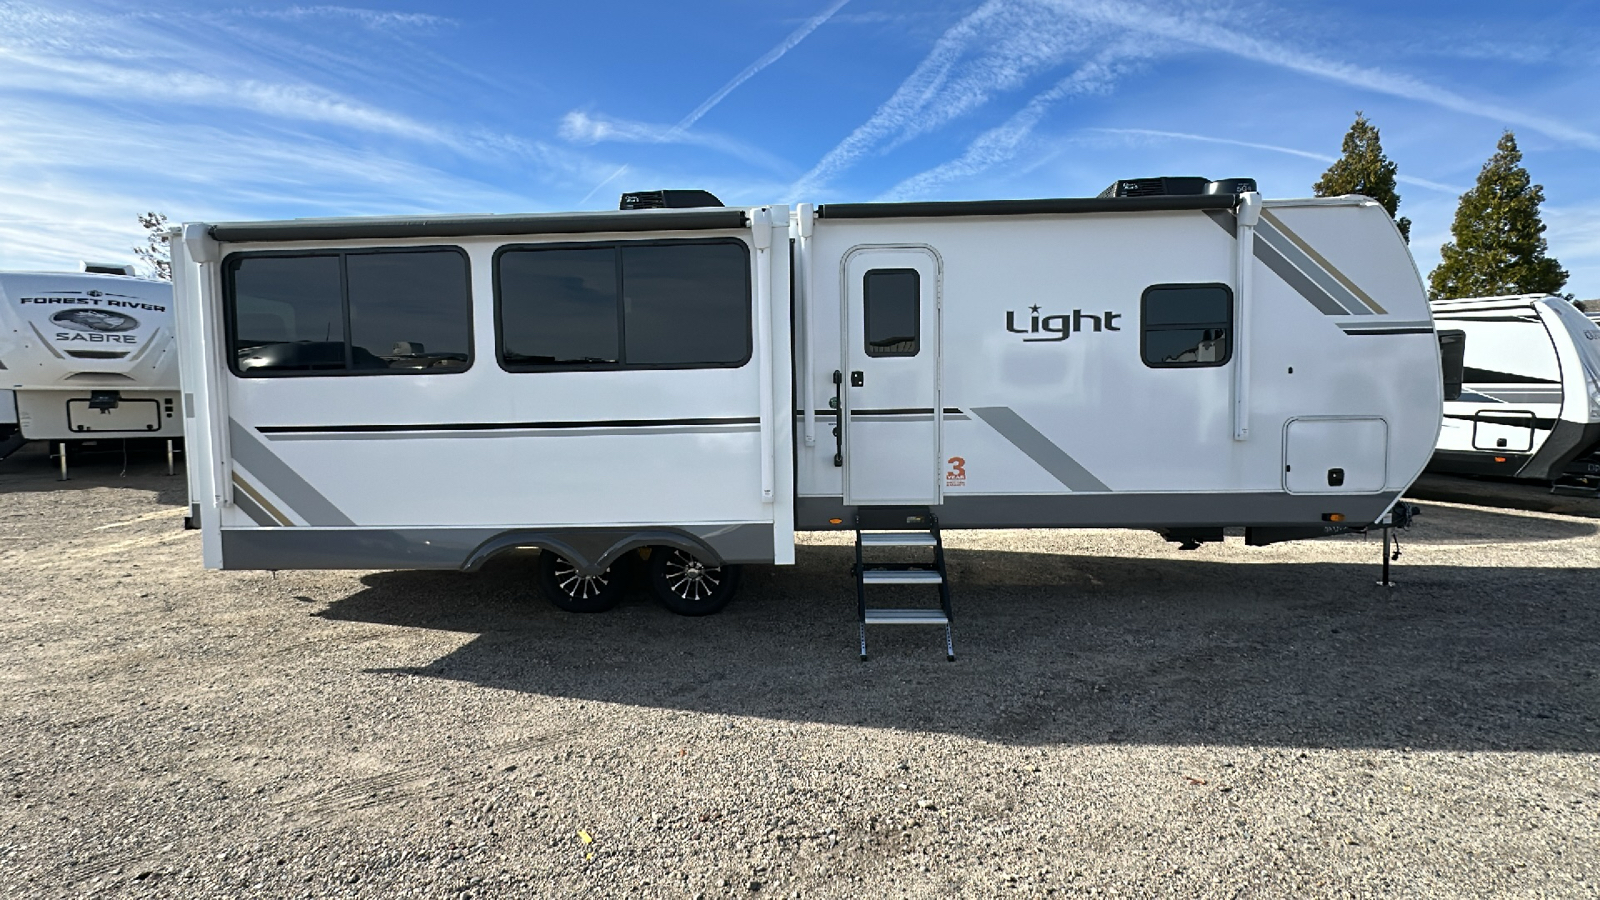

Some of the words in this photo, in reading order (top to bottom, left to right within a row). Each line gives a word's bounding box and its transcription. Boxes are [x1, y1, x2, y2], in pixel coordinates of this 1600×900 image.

[20, 297, 102, 305] FOREST
[108, 300, 166, 312] RIVER
[1006, 303, 1122, 342] Light
[56, 332, 138, 344] SABRE
[947, 456, 966, 476] 3
